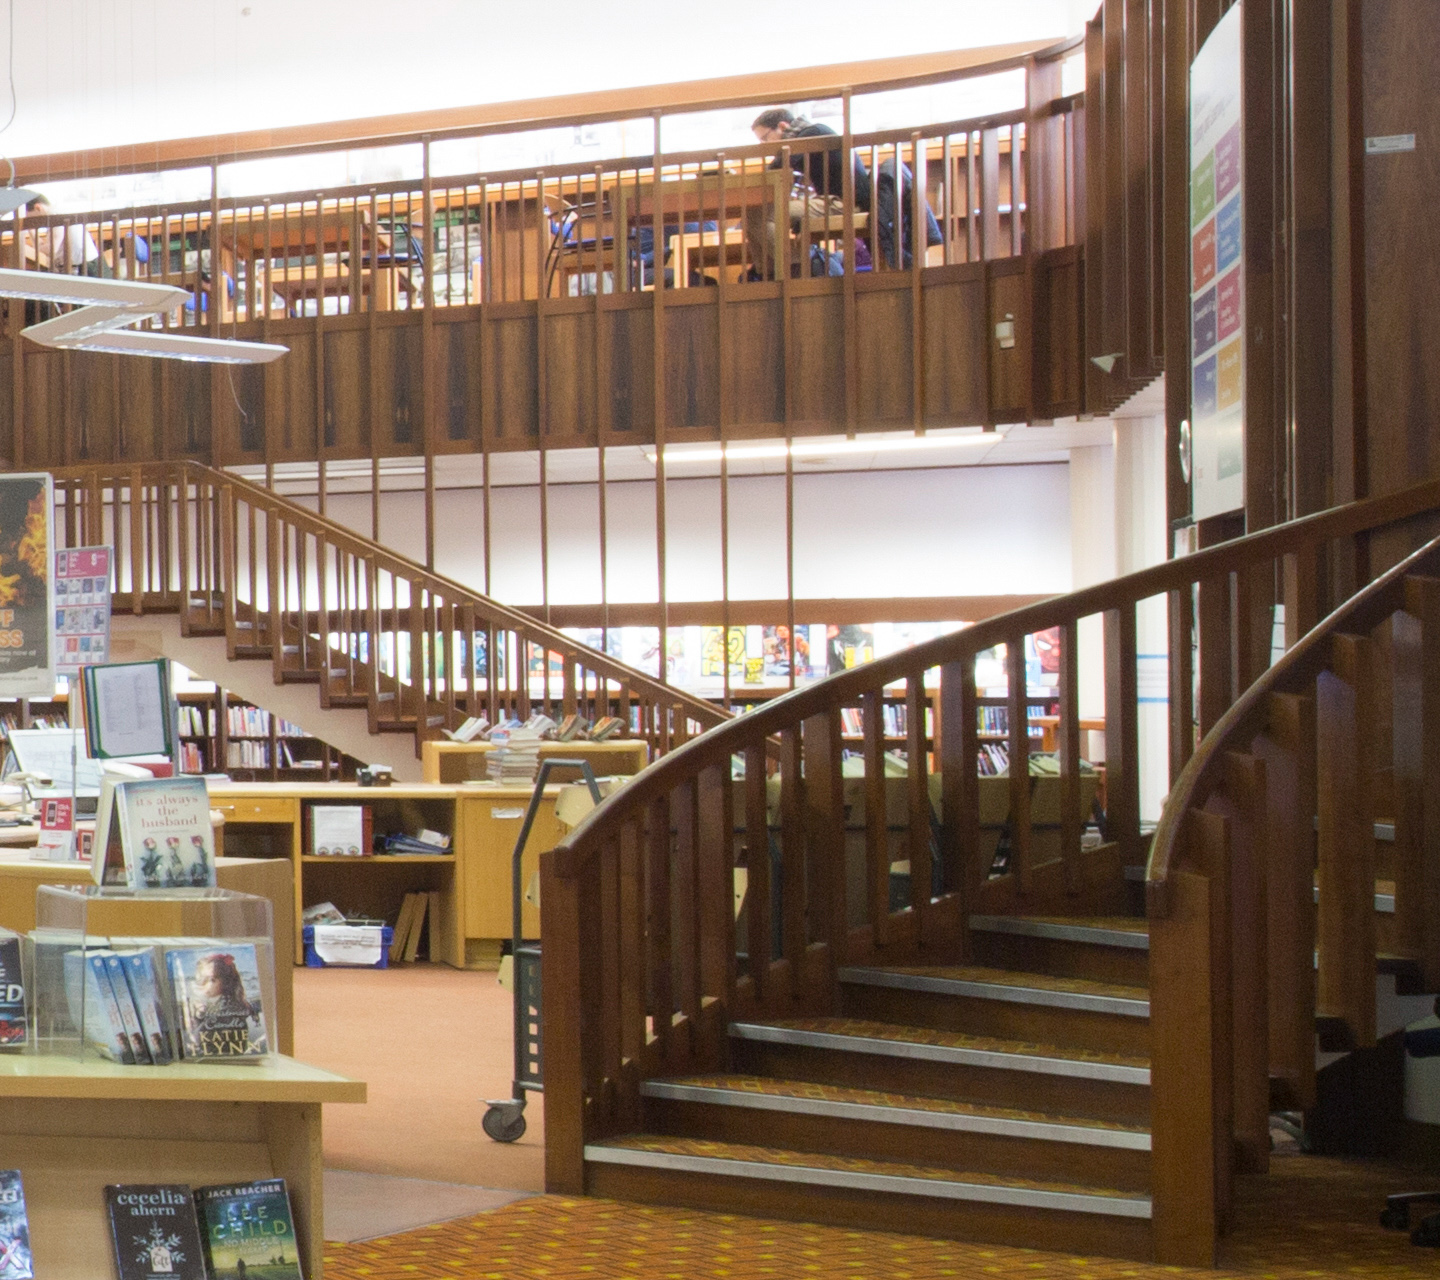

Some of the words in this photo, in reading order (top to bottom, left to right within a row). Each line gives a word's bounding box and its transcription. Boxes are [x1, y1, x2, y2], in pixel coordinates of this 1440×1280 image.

[157, 794, 198, 806] always
[158, 806, 178, 816] the
[141, 815, 197, 828] husband
[200, 1030, 249, 1042] KATIE
[117, 1190, 186, 1205] cecelia
[207, 1188, 232, 1199] JACK
[235, 1184, 281, 1196] REACHER
[130, 1206, 176, 1217] ahern
[227, 1205, 268, 1221] LEE
[213, 1220, 287, 1239] CHILD
